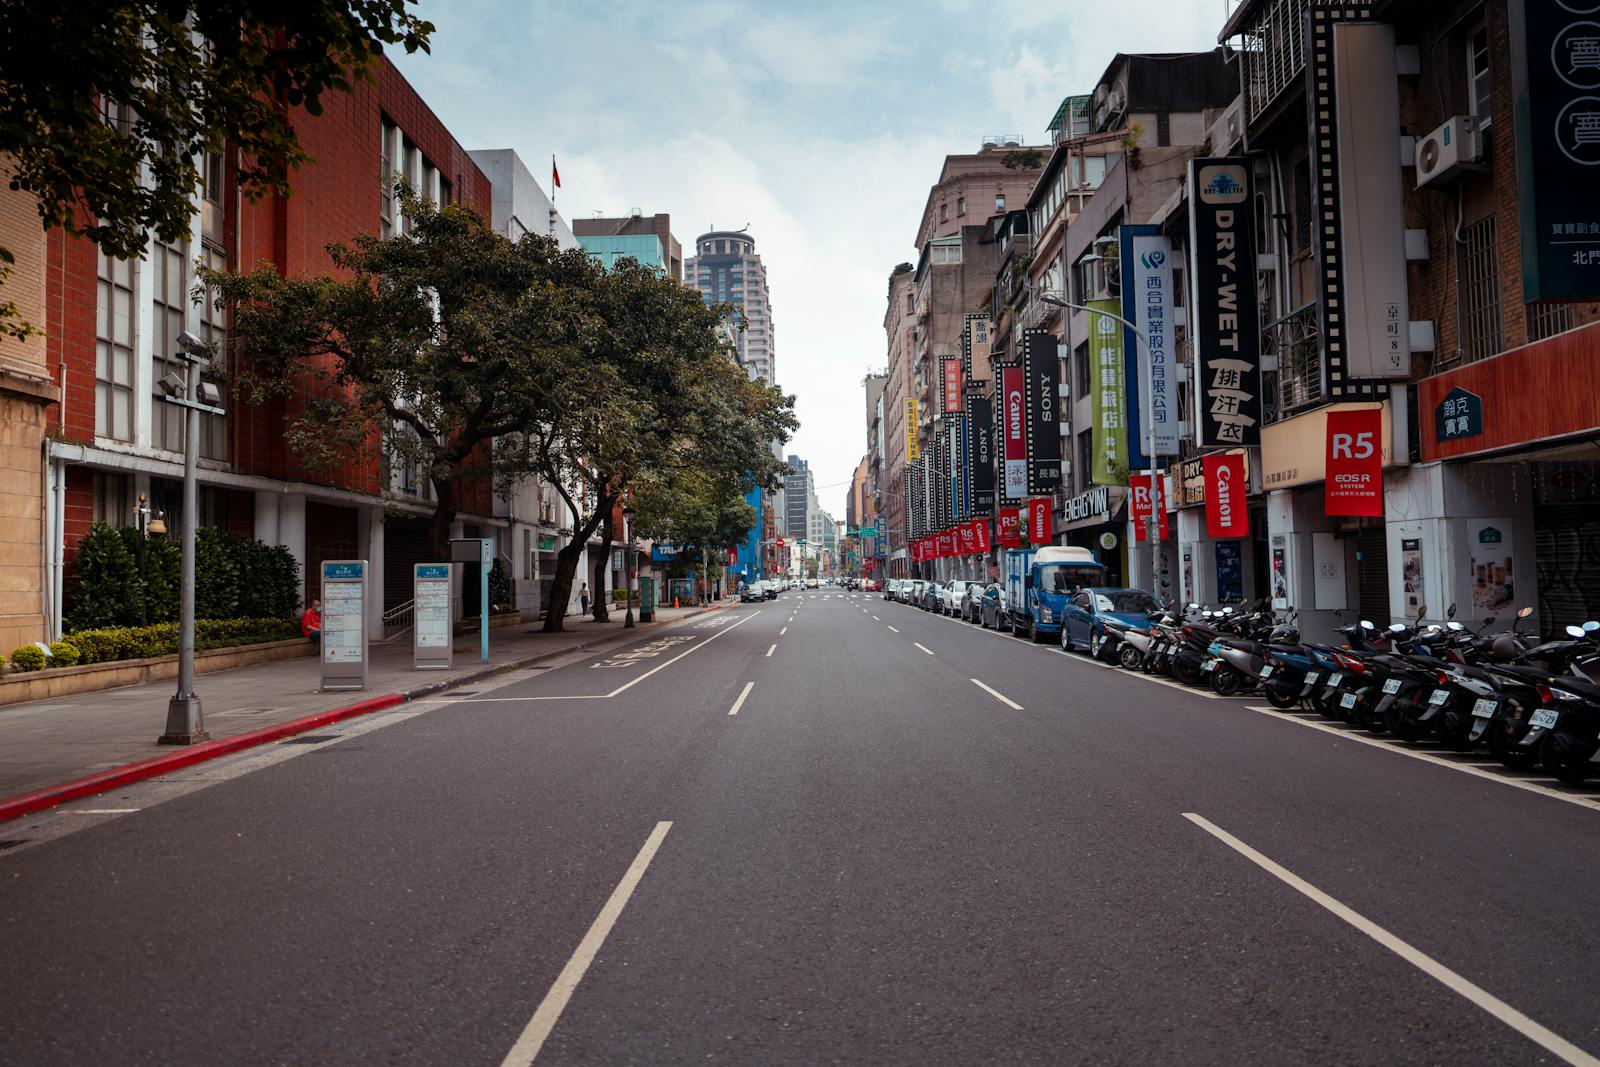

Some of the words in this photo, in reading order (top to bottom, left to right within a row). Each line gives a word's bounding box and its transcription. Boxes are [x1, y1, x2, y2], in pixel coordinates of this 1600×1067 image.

[1215, 209, 1239, 352] DRY-WET
[1010, 390, 1022, 440] Canon
[1041, 373, 1051, 422] SONY
[1217, 368, 1241, 440] 排汗衣
[980, 427, 988, 463] SONY
[1332, 431, 1374, 460] R5
[1335, 473, 1360, 482] EOS
[1361, 473, 1371, 482] R
[1217, 465, 1232, 527] Canon
[961, 529, 974, 538] R6
[976, 523, 985, 548] Canon
[1002, 516, 1017, 527] R5
[1036, 503, 1045, 538] Canon
